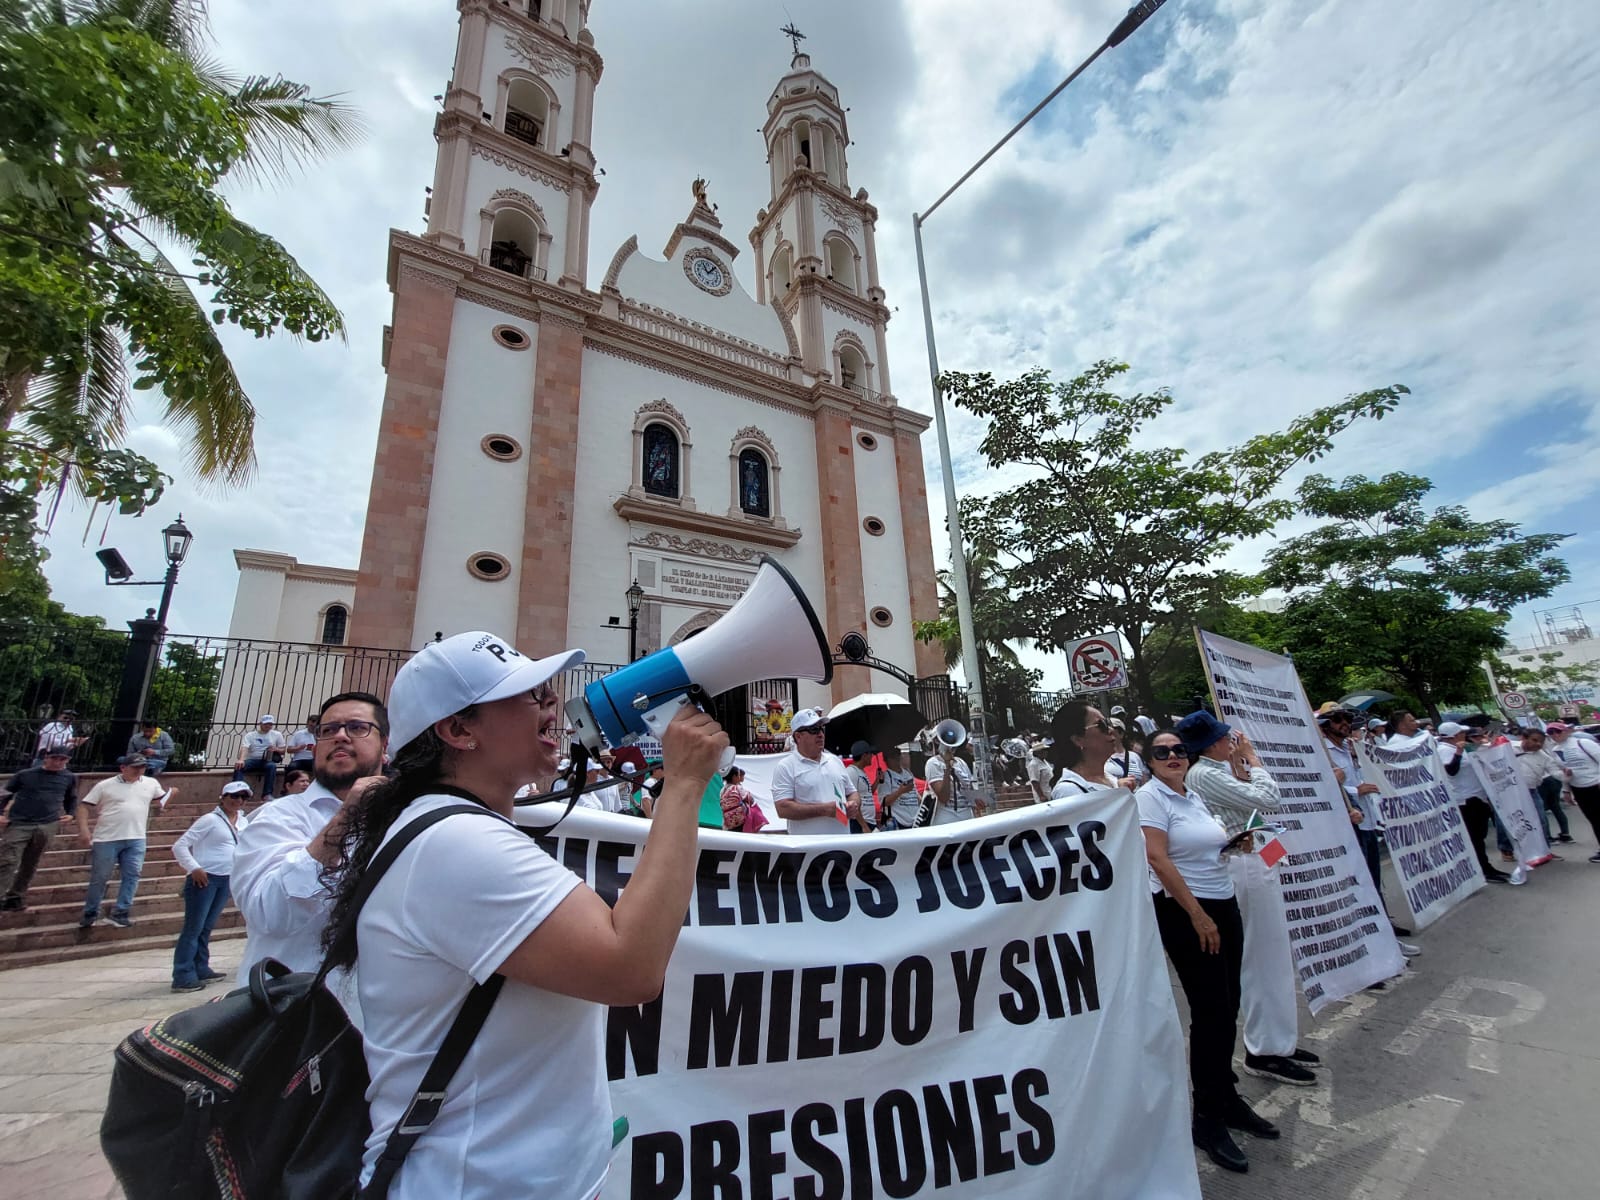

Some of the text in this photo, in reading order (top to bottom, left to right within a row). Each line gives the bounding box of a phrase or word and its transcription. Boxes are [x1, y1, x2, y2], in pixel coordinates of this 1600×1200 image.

[1508, 695, 1520, 704] 30
[915, 821, 1113, 913] JUECES
[687, 954, 934, 1070] MIEDO
[950, 946, 988, 1033] Y
[999, 930, 1100, 1026] SIN
[631, 1068, 1056, 1200] PRESIONES
